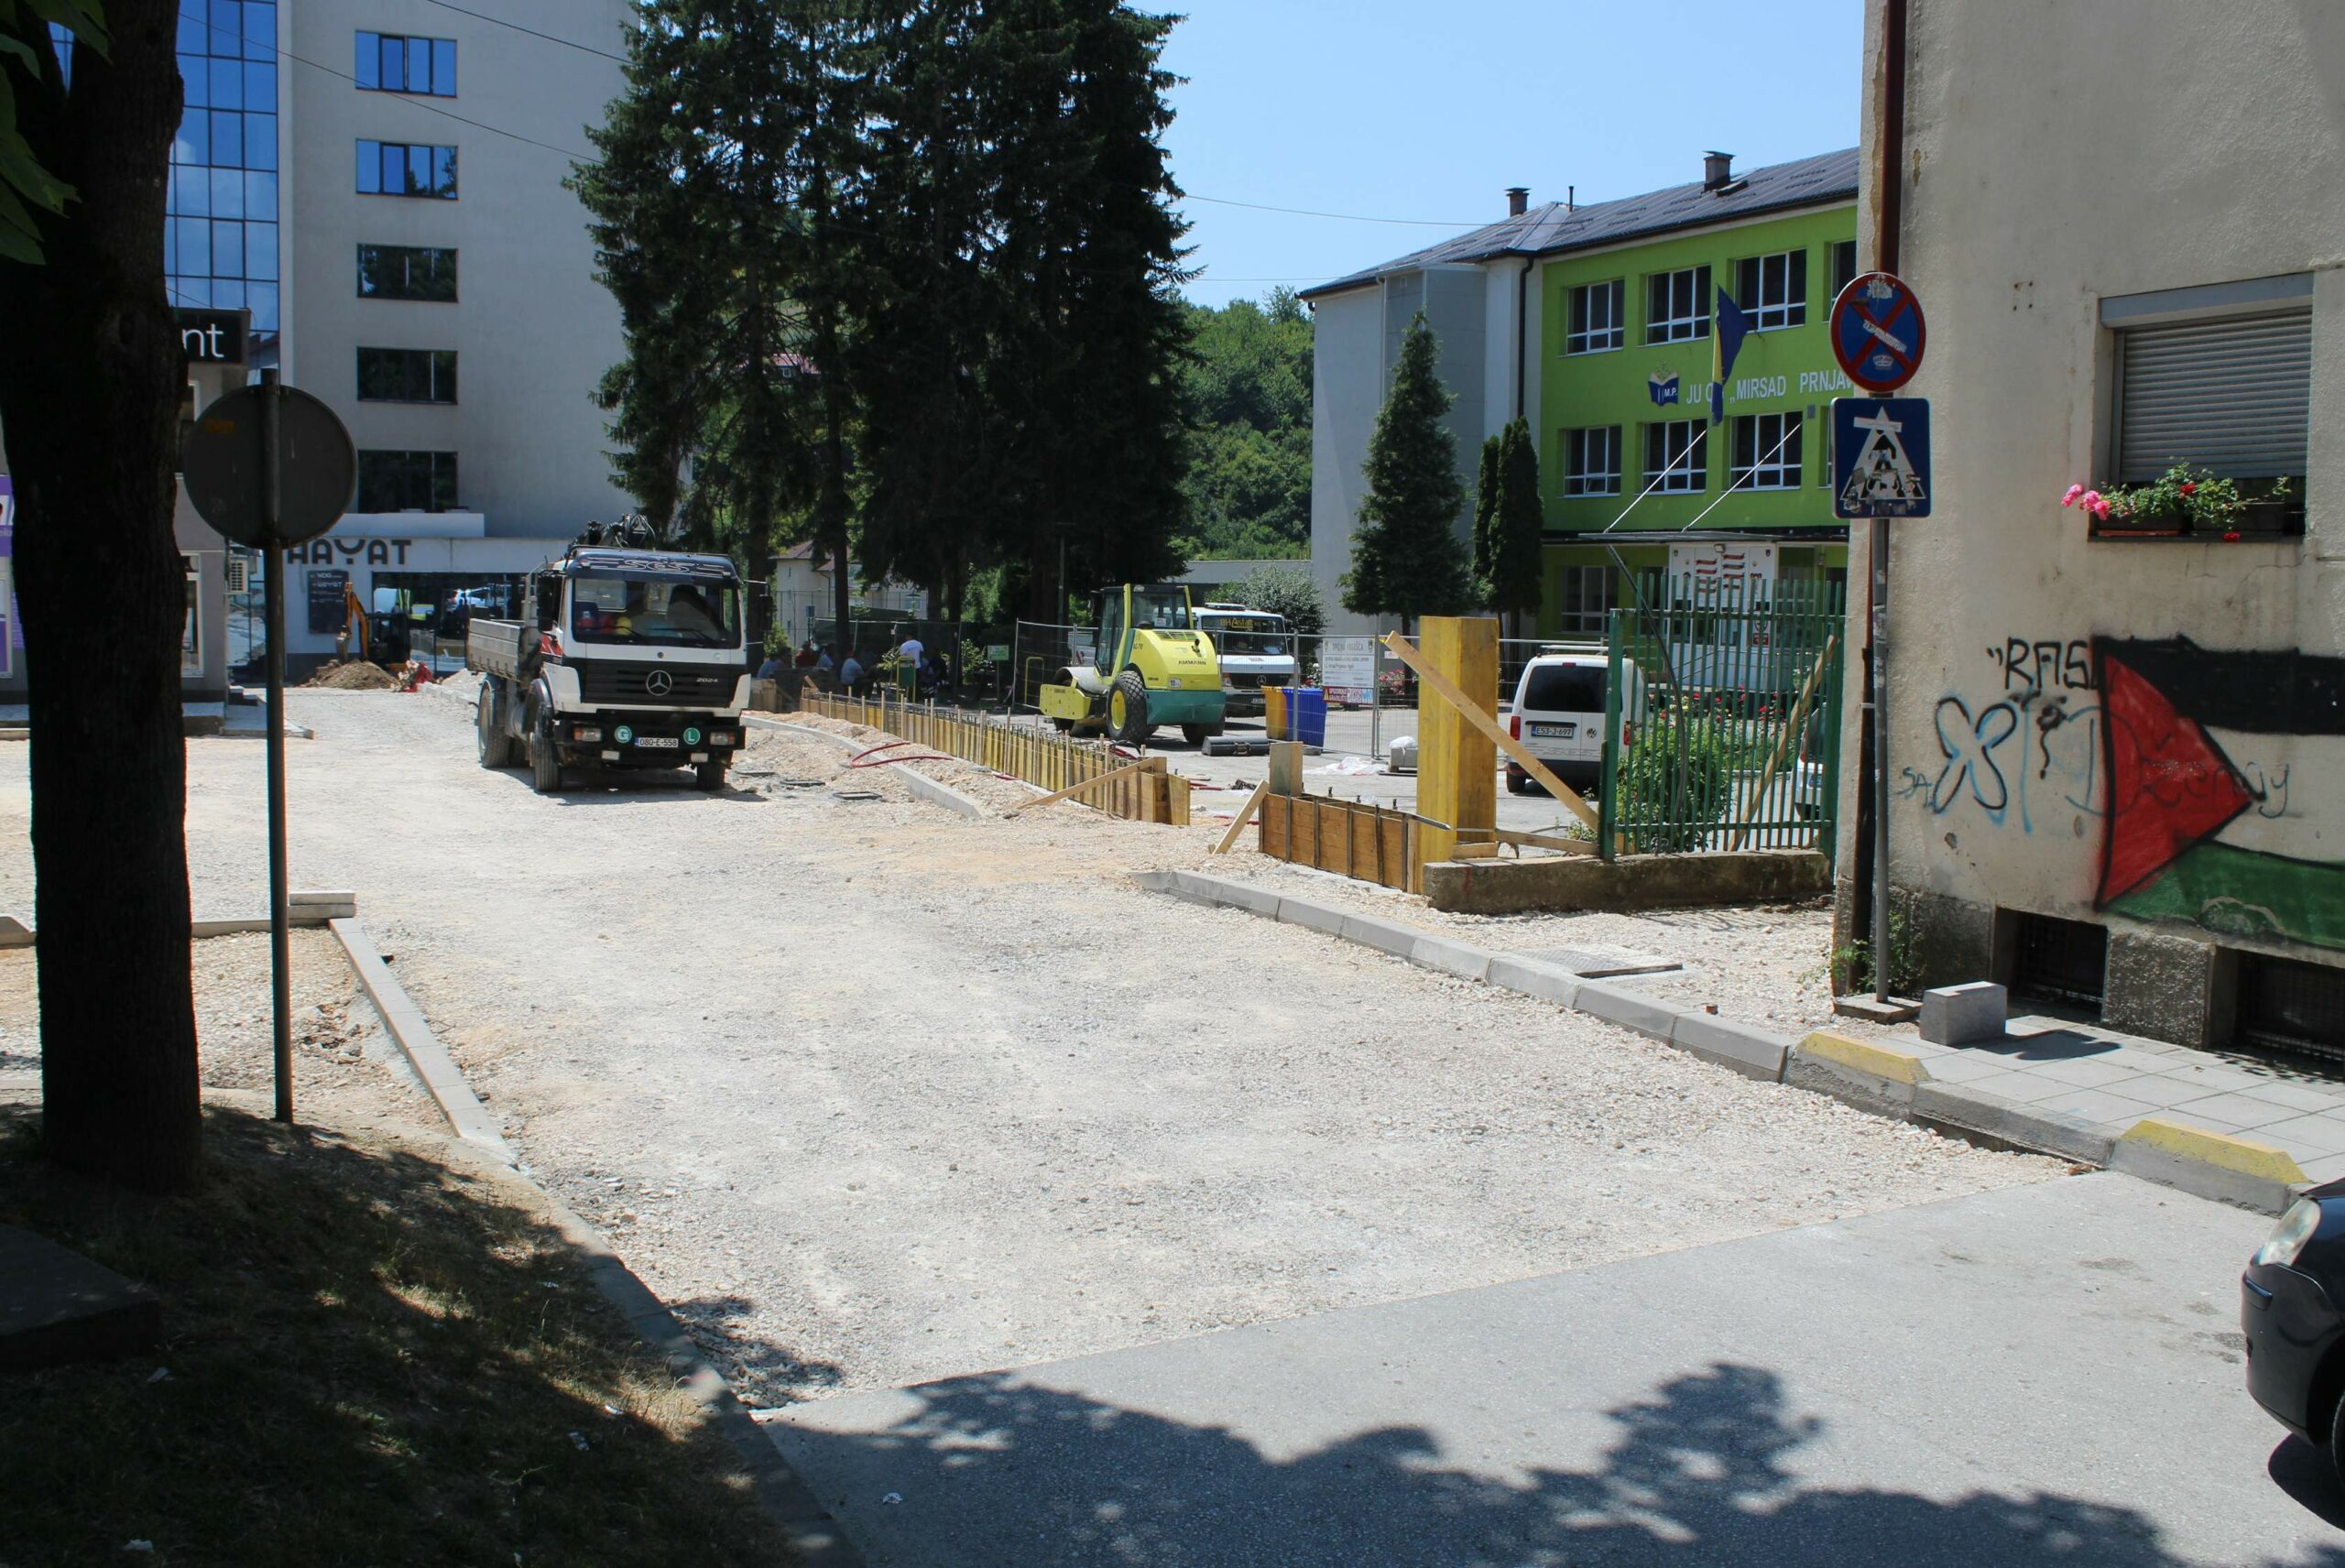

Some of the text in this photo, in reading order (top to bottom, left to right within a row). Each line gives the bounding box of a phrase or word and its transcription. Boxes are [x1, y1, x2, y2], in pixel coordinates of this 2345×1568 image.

[288, 539, 411, 565] HAYAT
[1536, 726, 1572, 735] E53-J-697
[639, 738, 677, 746] 080-E-558
